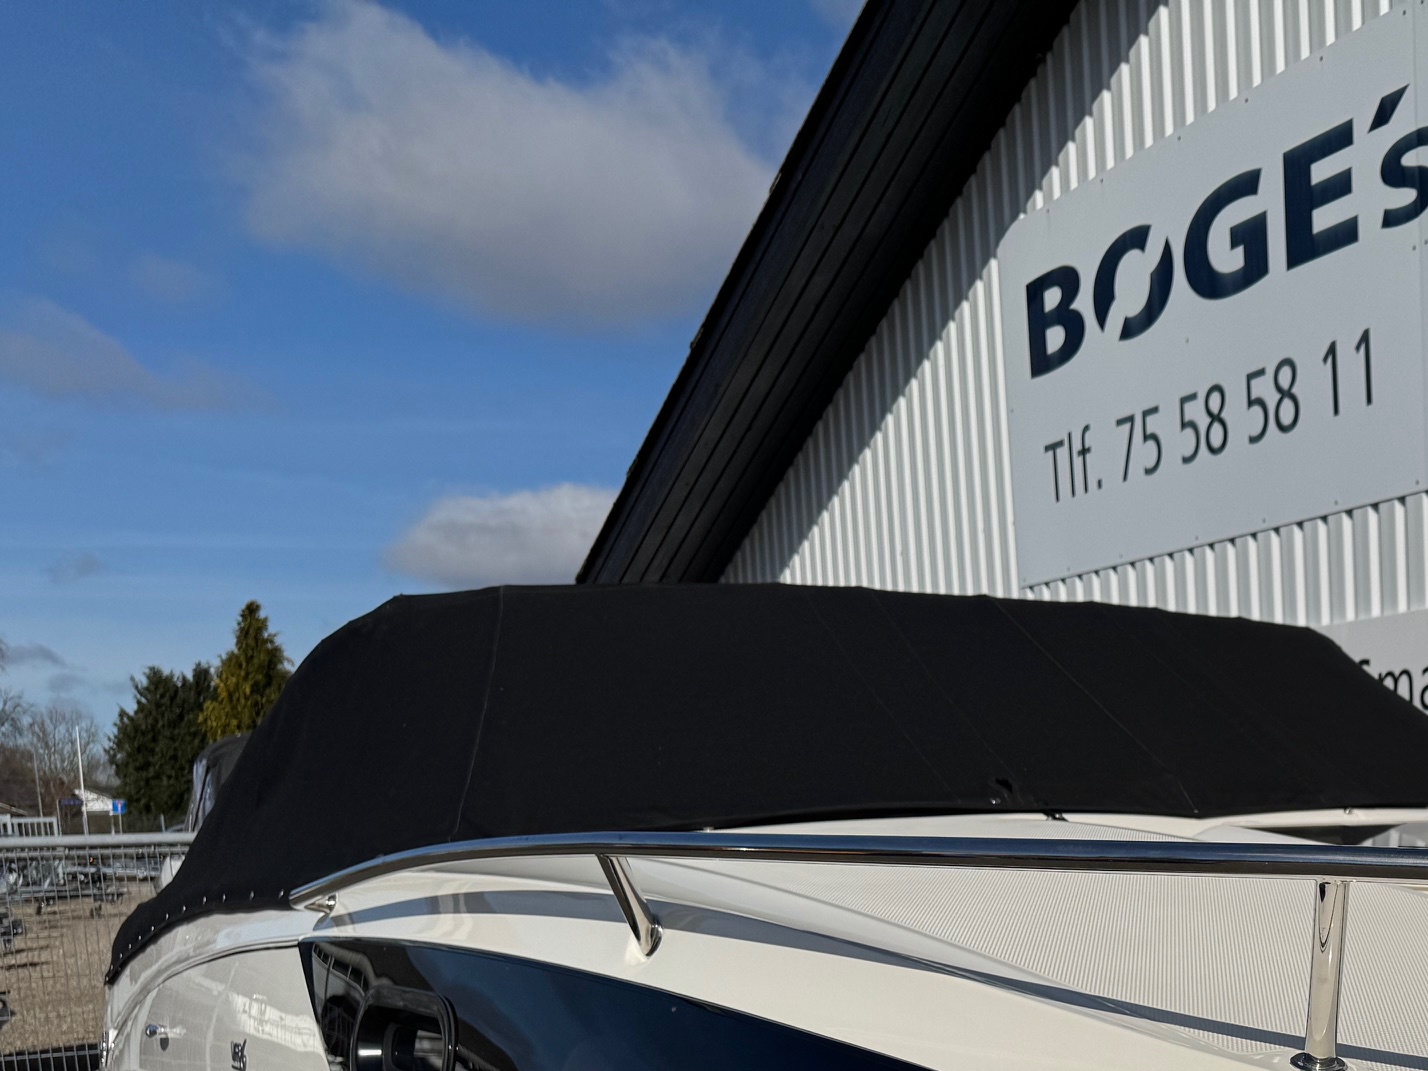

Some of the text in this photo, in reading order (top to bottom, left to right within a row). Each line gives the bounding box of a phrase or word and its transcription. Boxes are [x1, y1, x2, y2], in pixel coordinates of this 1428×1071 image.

[1044, 328, 1372, 502] Tlf. 75 58 58 11
